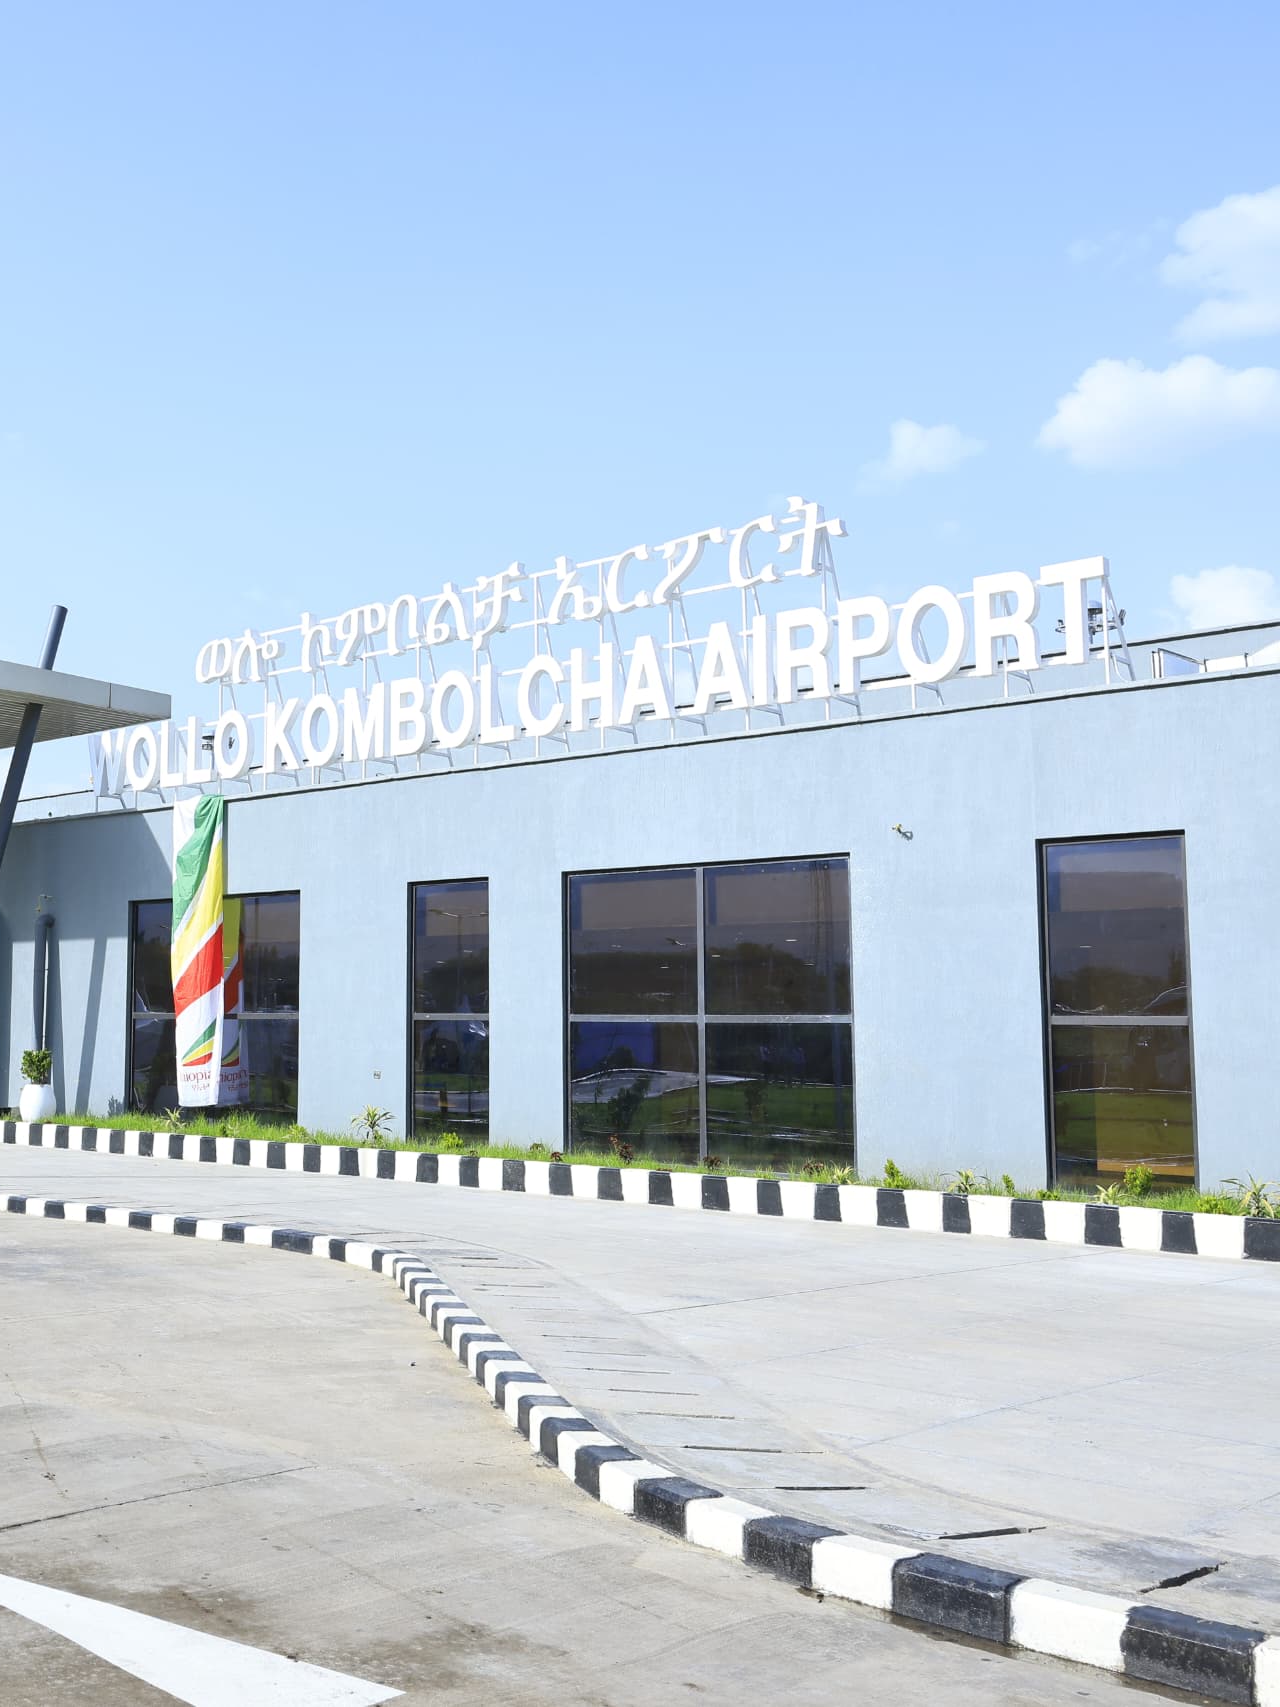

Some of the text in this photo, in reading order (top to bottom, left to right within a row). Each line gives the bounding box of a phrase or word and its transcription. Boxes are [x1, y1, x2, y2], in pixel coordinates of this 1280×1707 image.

[88, 555, 1110, 797] WOLLO KOMBOLCHA AIRPORT
[195, 496, 848, 684] ወሎ ኮምቦልቻ ኤርፖርት
